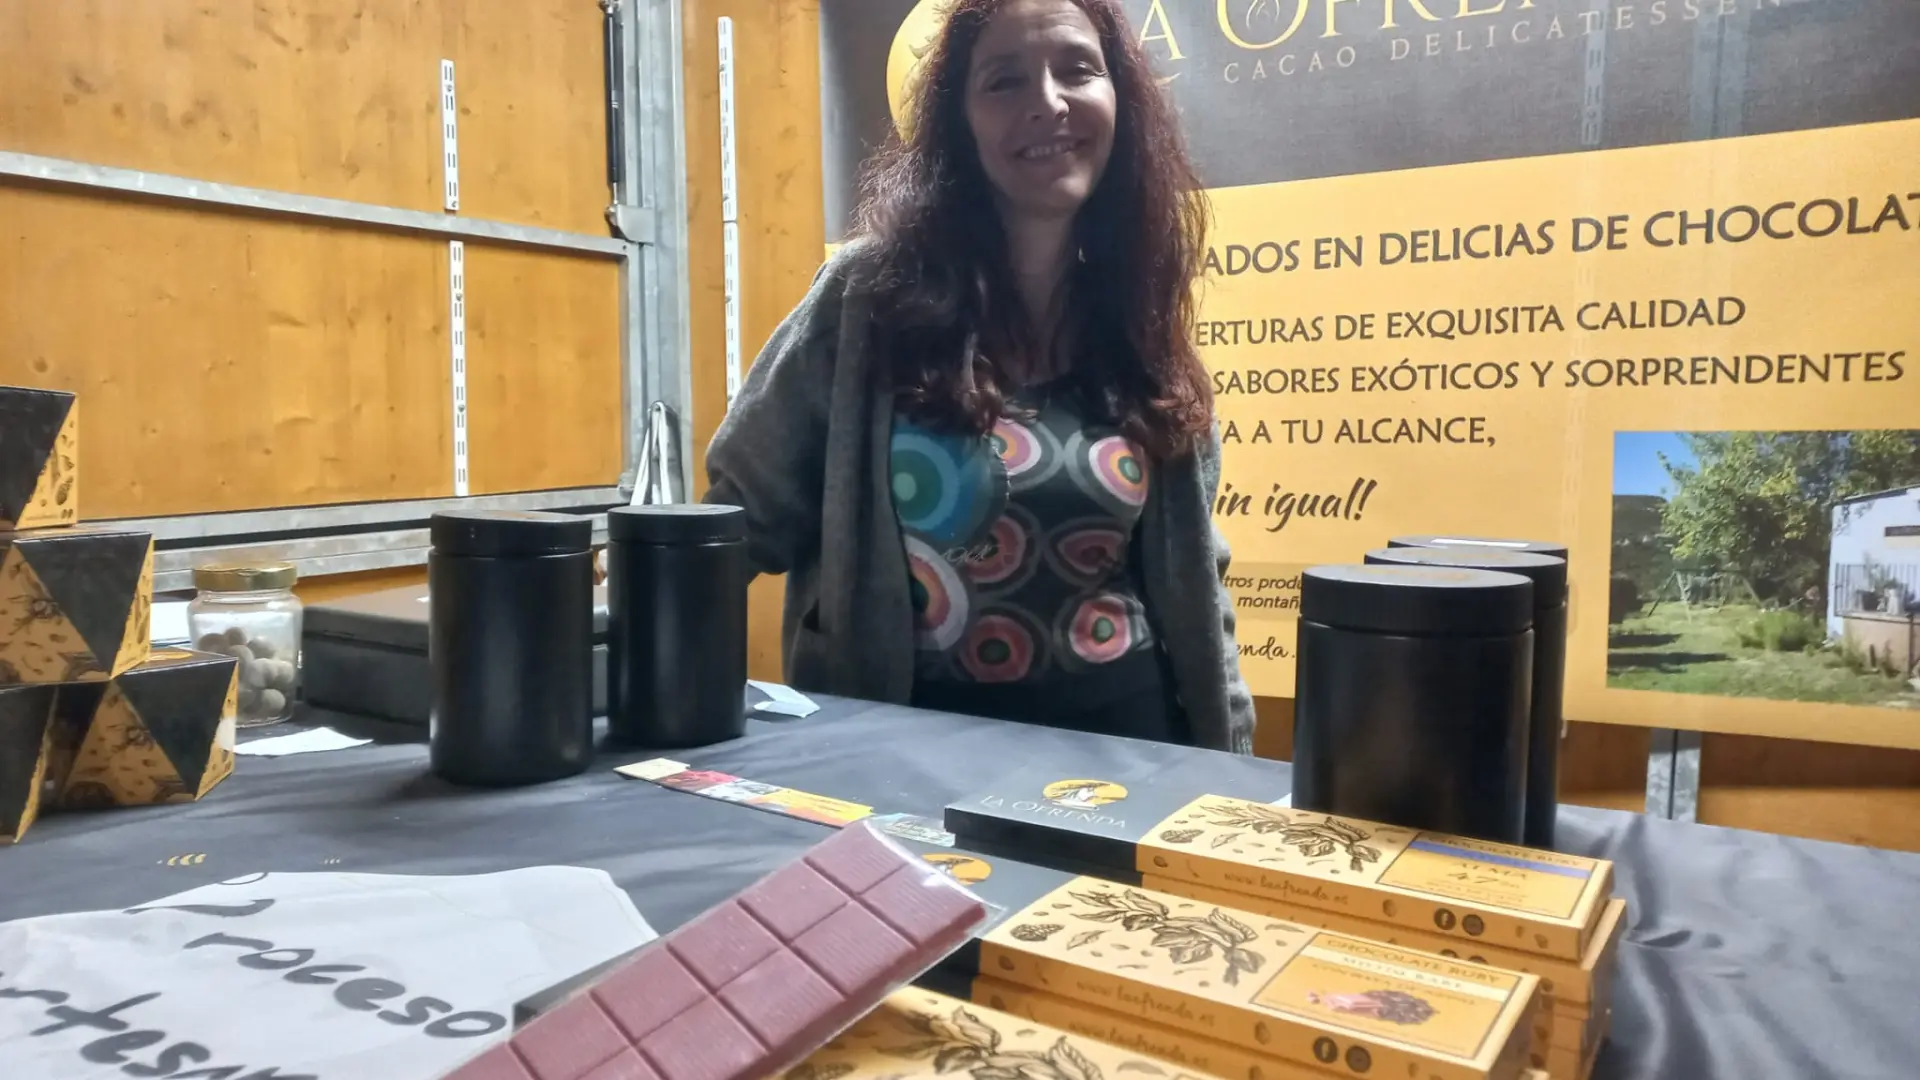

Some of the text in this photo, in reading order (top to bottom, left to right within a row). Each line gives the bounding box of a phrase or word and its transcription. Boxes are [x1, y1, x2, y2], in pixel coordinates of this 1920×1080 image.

[1138, 0, 1187, 61] A
[1223, 0, 1783, 84] CACAO DELICATESSE
[1202, 239, 1301, 277] ADOS
[1313, 235, 1364, 270] EN
[1379, 219, 1556, 266] DELICIAS
[1571, 214, 1630, 253] DE
[1195, 296, 1747, 346] ERTURAS DE EXQUISITA CALIDAD
[1213, 350, 1907, 395] SABORES EXÓTICOS Y SORPRENDENTES
[1219, 416, 1497, 447] A A TU ALCANCE,
[1215, 482, 1252, 518] in
[1223, 575, 1254, 589] tros
[1237, 595, 1301, 610] montañ
[1326, 939, 1442, 970] CHOCOLATE
[1448, 965, 1501, 983] RUBY
